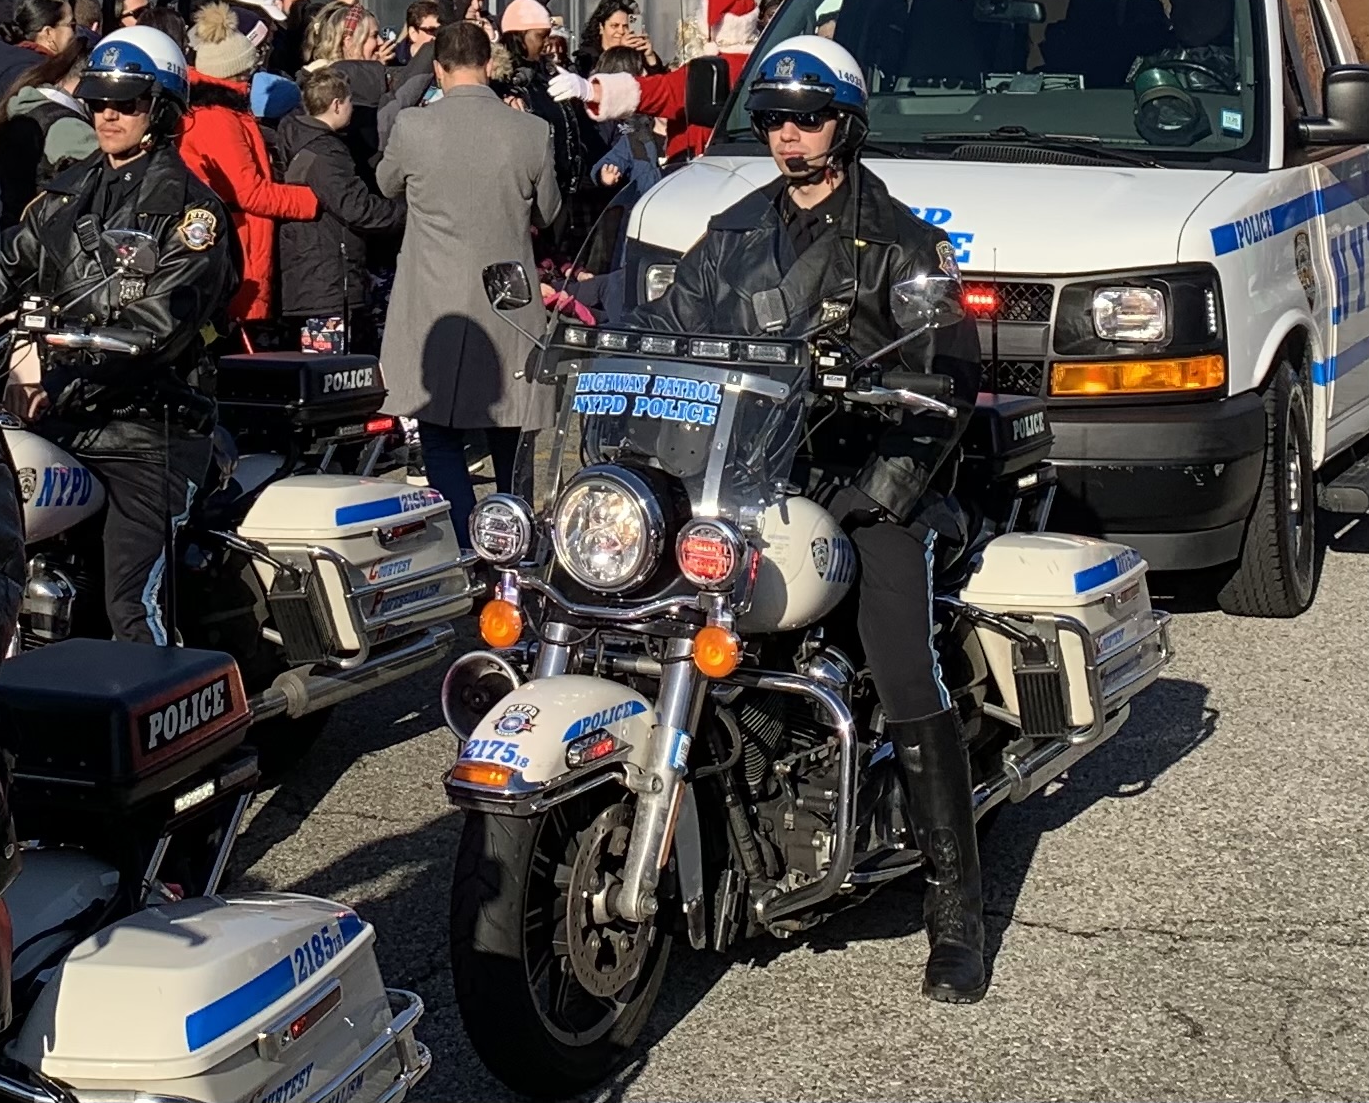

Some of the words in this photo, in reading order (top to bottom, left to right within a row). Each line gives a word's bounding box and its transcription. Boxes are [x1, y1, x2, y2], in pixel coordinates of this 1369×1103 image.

[1235, 208, 1273, 249] POLICE
[323, 367, 373, 393] POLICE
[576, 373, 650, 393] HIGHWAY
[652, 376, 722, 403] PATROL
[572, 394, 627, 415] NYPD
[632, 396, 718, 426] POLICE
[1012, 411, 1045, 441] POLICE
[35, 467, 93, 507] NYPD
[148, 679, 225, 749] POLICE
[507, 704, 538, 717] NYPD
[580, 701, 633, 735] POLICE
[463, 739, 519, 763] 2175
[294, 925, 334, 984] 2185
